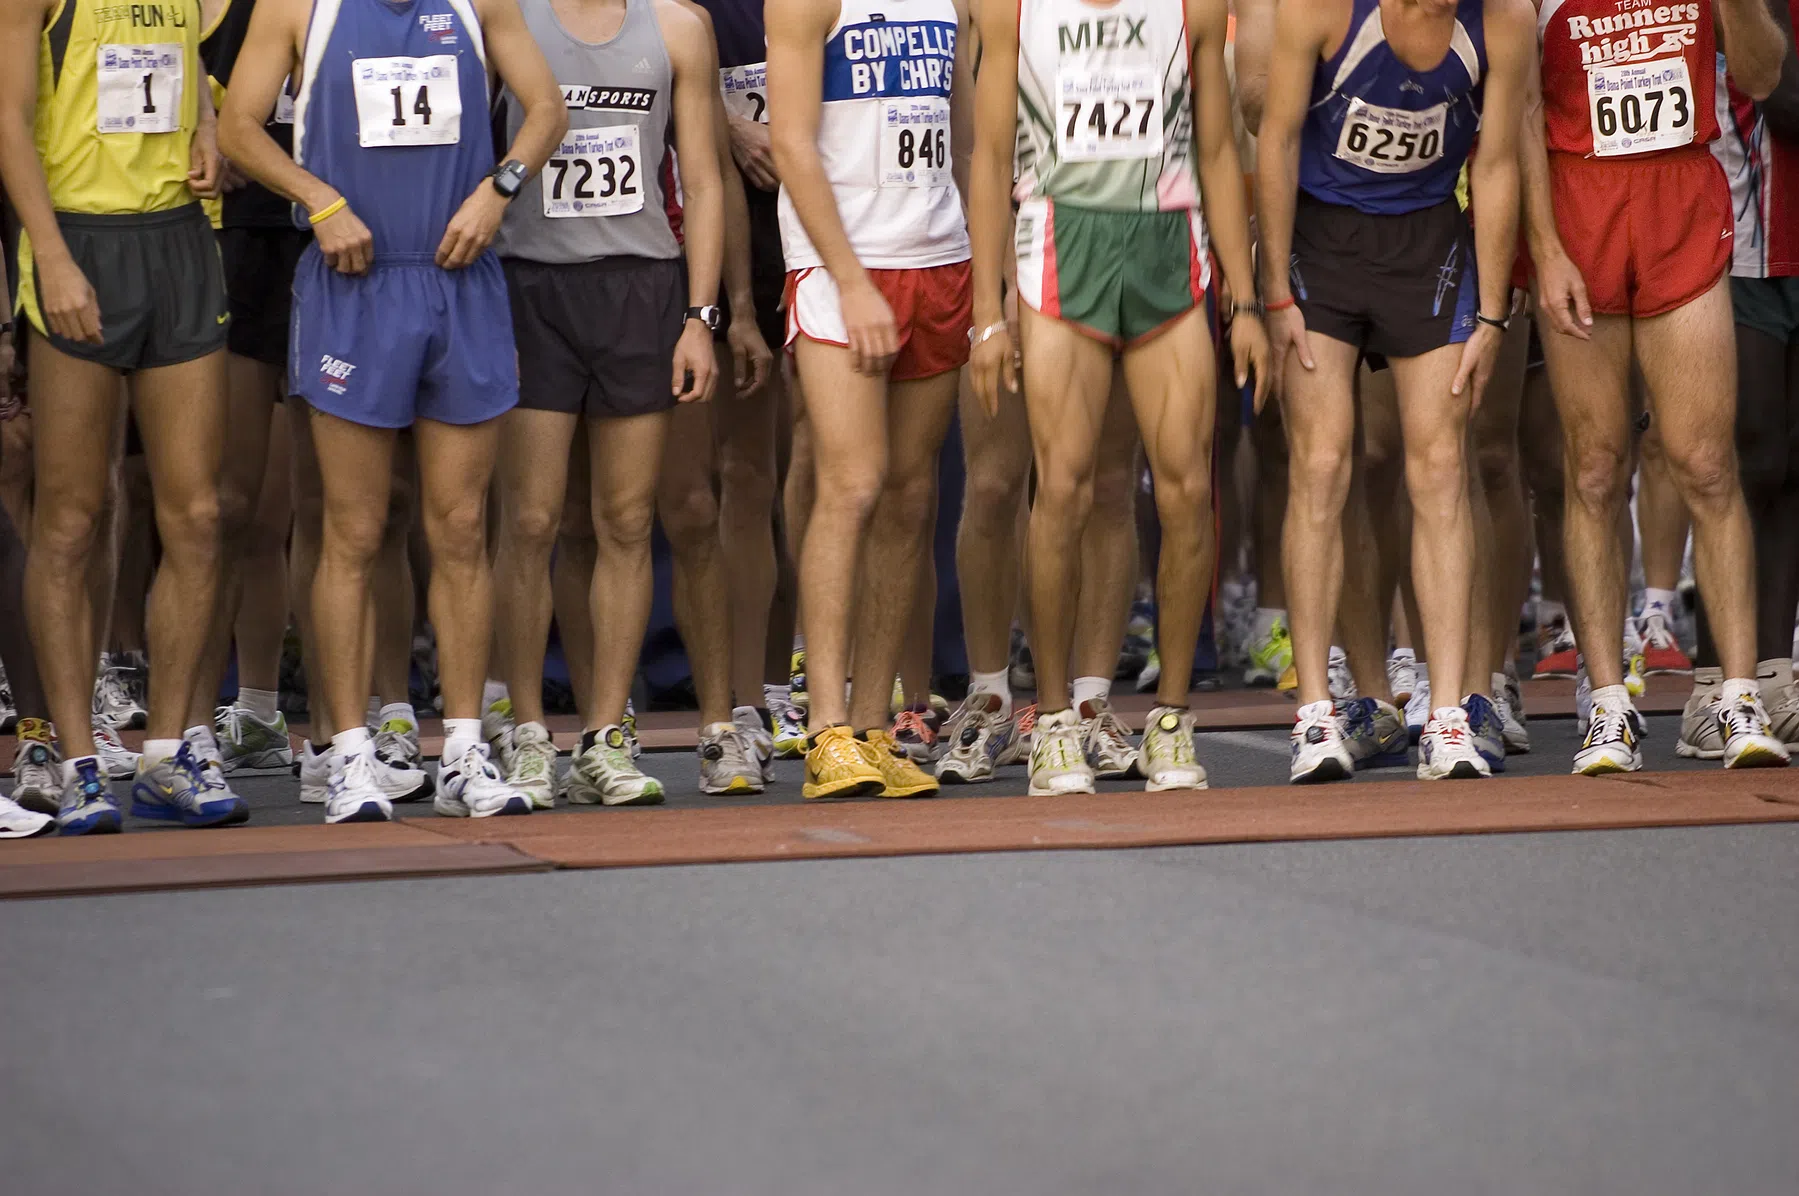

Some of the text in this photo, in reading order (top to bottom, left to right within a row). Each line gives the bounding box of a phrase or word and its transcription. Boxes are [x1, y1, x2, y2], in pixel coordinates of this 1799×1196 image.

[131, 5, 165, 27] FUN
[419, 14, 454, 25] FLEET
[1567, 2, 1699, 40] Runners
[1615, 0, 1651, 11] TEAM
[423, 22, 453, 32] FEET
[1058, 15, 1148, 54] MEX
[1579, 30, 1652, 66] high
[143, 73, 156, 114] 1
[852, 61, 886, 94] BY
[391, 85, 432, 126] 14
[1063, 97, 1154, 142] 7427
[1597, 86, 1689, 137] 6073
[898, 129, 944, 169] 846
[1347, 122, 1439, 161] 6250
[549, 155, 637, 200] 7232
[320, 354, 357, 373] FLEET
[320, 363, 351, 380] FEET
